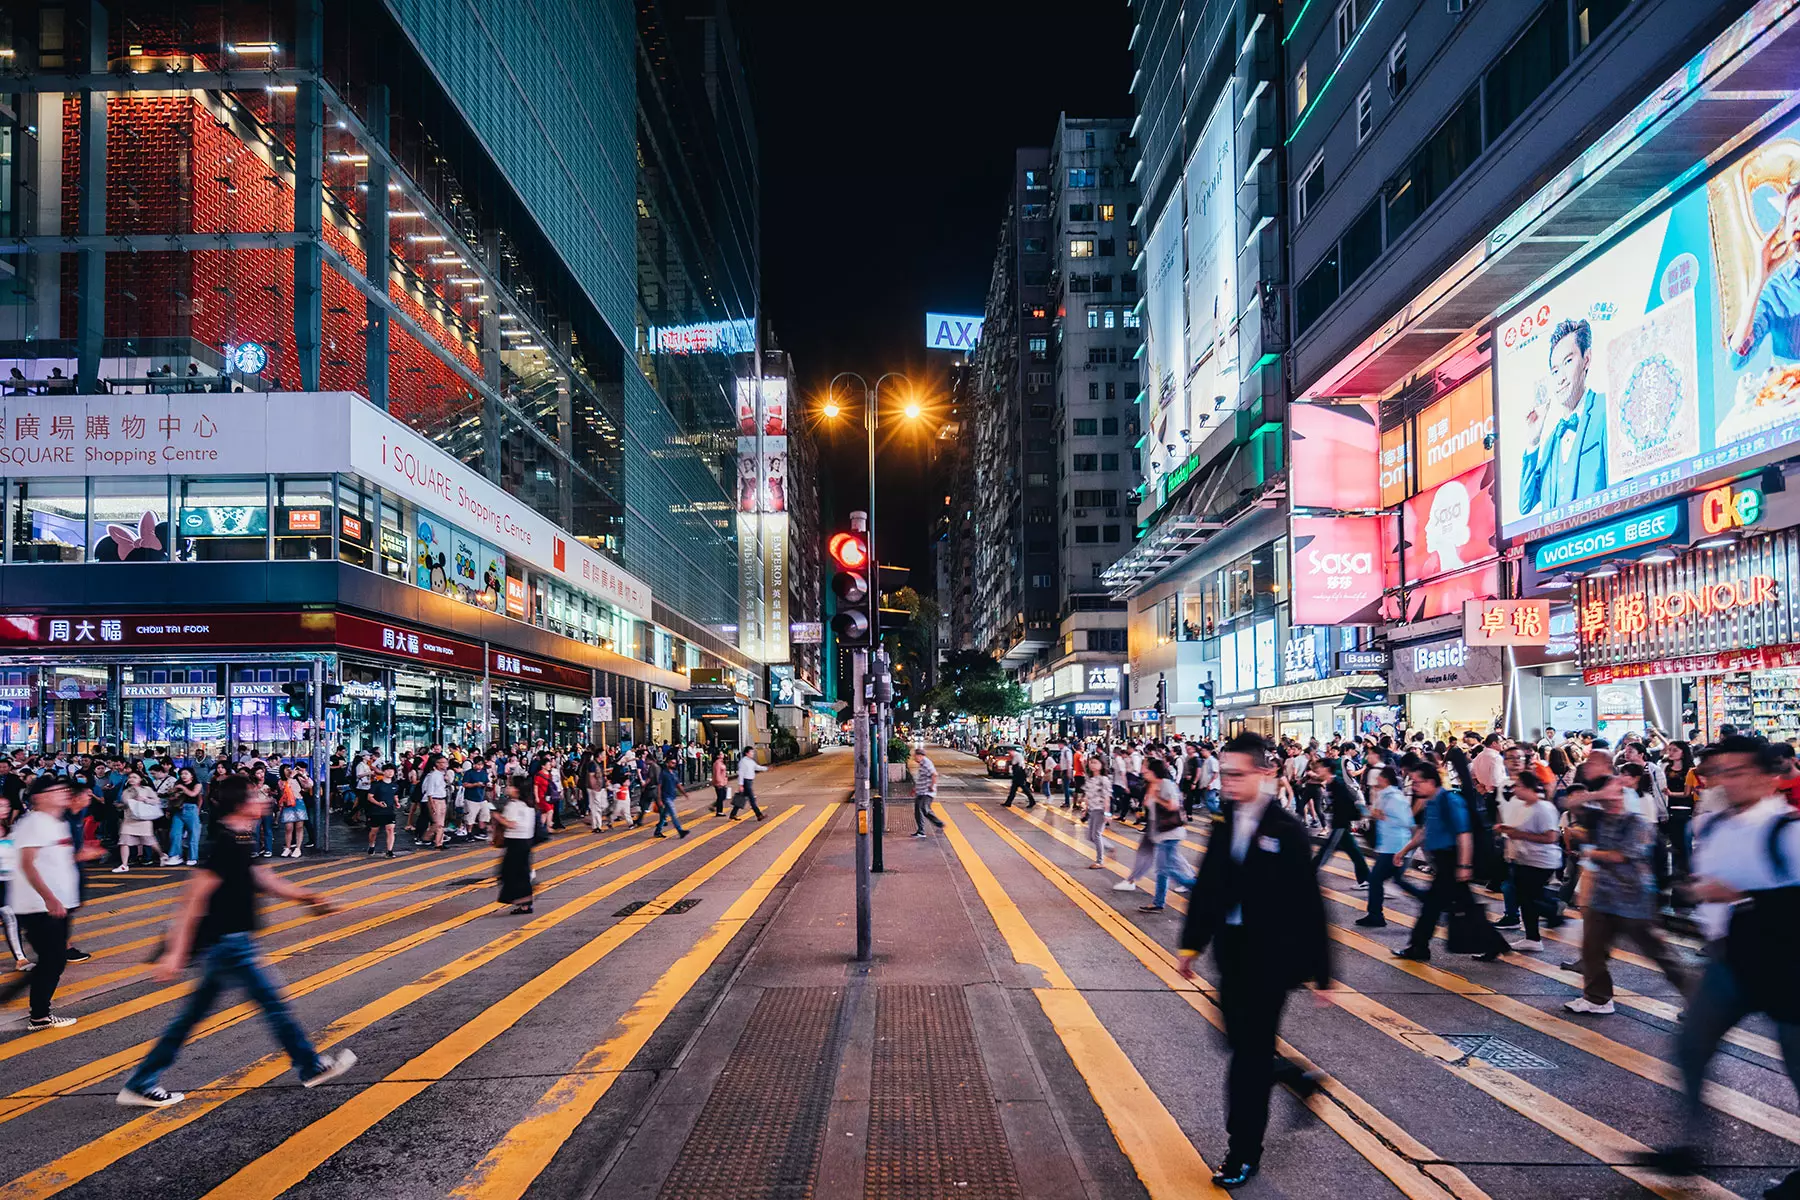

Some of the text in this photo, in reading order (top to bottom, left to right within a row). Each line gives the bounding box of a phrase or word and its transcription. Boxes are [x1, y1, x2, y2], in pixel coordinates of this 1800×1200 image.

[935, 321, 983, 345] AX
[0, 445, 218, 466] SQUARE Shopping Centre
[1168, 454, 1199, 493] Holiday Inn
[381, 435, 532, 545] i SQUARE Shopping Centre
[1525, 529, 1541, 542] JM
[1545, 508, 1609, 536] NETWORK
[1543, 515, 1666, 564] watsons 屈臣氏
[773, 535, 782, 586] EMPEROR
[1308, 550, 1372, 575] Sasa
[1327, 576, 1352, 589] 莎莎
[1653, 574, 1779, 621] BONJOUR
[49, 620, 210, 642] 周大福 CHOW TAI FOOK
[383, 628, 419, 654] 周大福
[497, 655, 521, 674] 周大福
[1728, 653, 1762, 670] SALE
[1425, 674, 1442, 684] design
[1447, 673, 1458, 681] life
[1588, 669, 1613, 684] SALE
[124, 686, 214, 695] FRANCK MULLER
[233, 685, 275, 694] FRANCK
[655, 691, 669, 711] M&S
